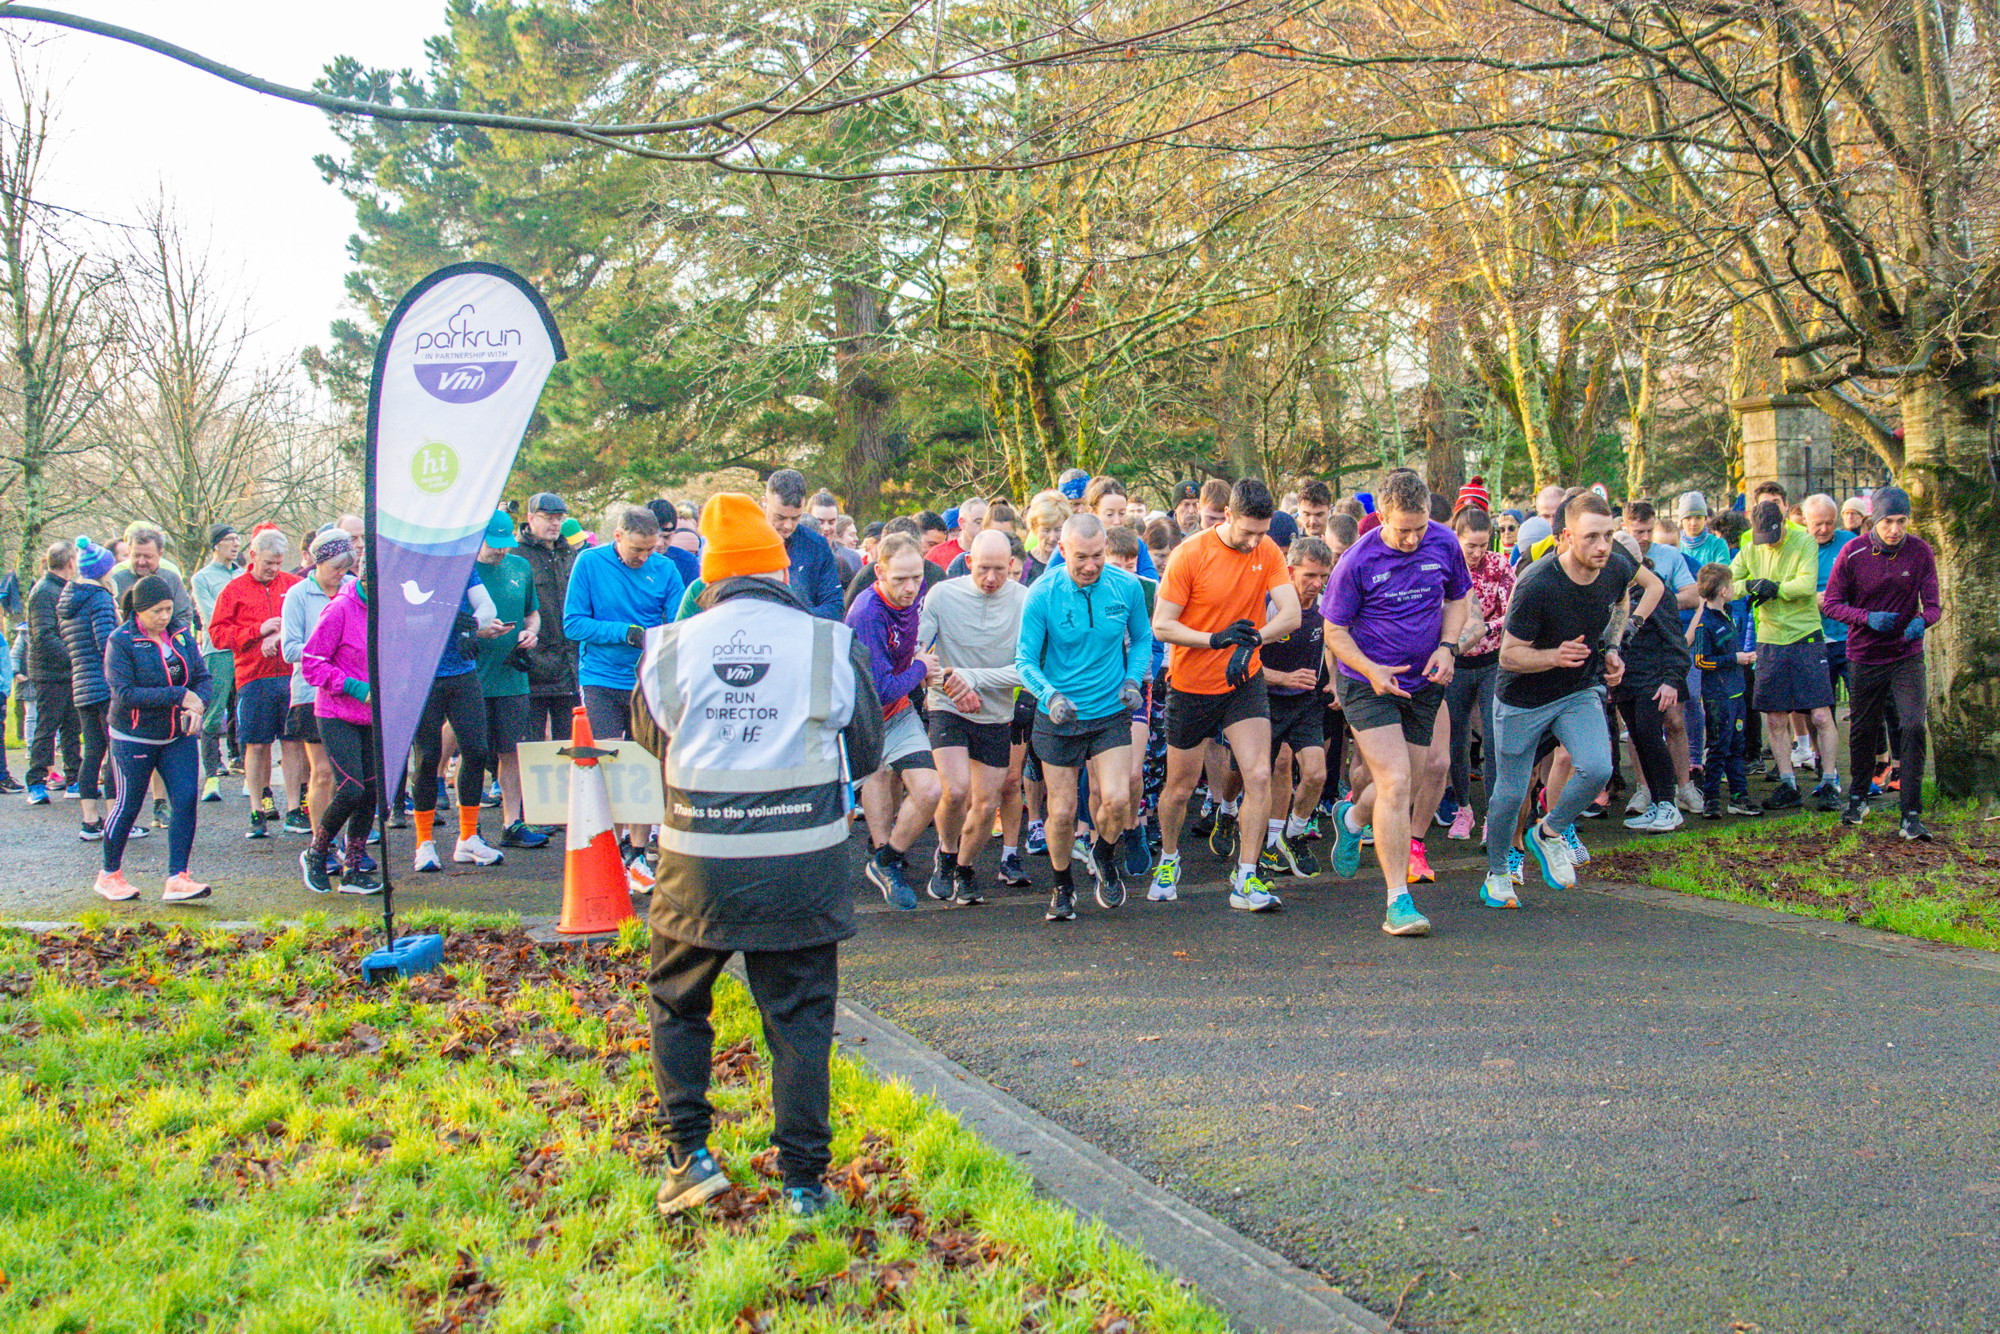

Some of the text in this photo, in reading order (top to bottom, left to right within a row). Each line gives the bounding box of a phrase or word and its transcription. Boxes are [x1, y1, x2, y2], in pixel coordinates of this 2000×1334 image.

[414, 304, 521, 354] parkrun
[435, 351, 486, 359] PARTNERSHIP
[488, 350, 508, 358] WITH
[437, 365, 486, 391] Vhi
[422, 449, 449, 475] hi
[712, 629, 772, 658] parkrun
[727, 664, 754, 680] Vhi
[725, 692, 756, 704] RUN
[706, 707, 779, 720] DIRECTOR
[673, 802, 813, 819] Thanks to the volunteers
